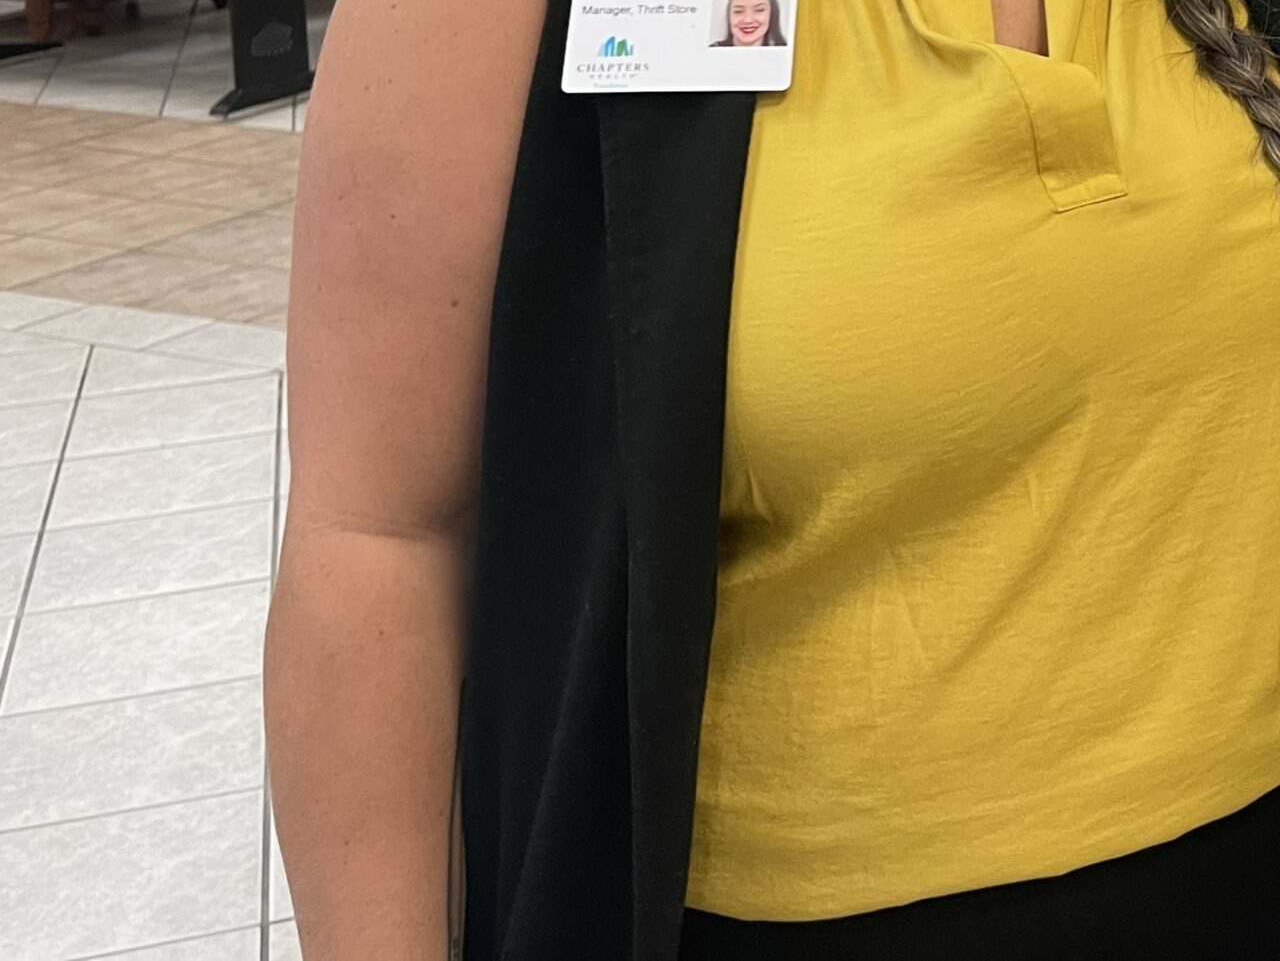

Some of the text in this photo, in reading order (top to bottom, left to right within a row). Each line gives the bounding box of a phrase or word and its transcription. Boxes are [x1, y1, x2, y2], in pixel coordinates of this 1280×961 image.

[581, 4, 697, 16] Manager, Thrift Store
[576, 62, 650, 73] CHAPTERS
